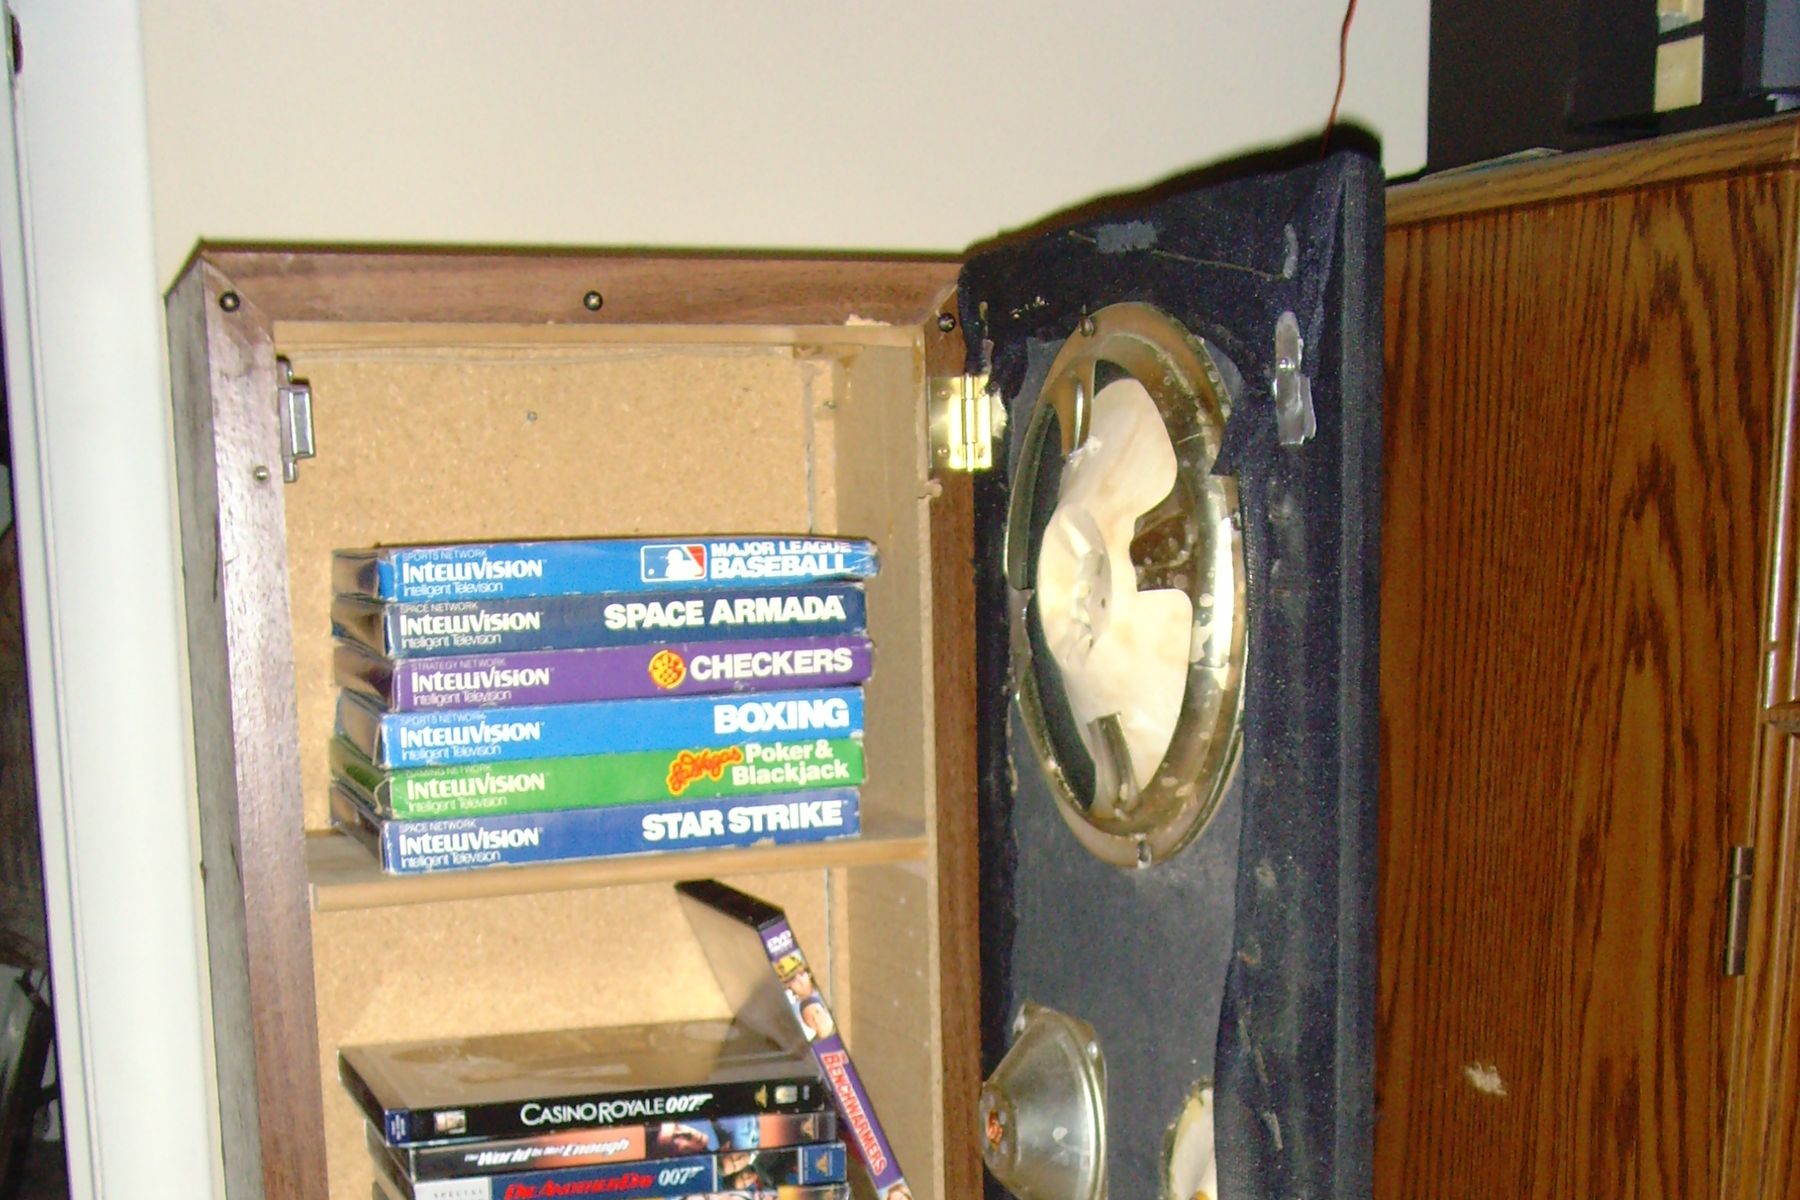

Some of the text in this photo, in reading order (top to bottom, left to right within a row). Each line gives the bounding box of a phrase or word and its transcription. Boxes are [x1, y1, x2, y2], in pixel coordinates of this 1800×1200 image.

[402, 549, 487, 562] SPORTS NETWORK
[710, 540, 852, 557] MAJOR LEAGUE
[710, 553, 853, 580] BASEBALL
[403, 581, 504, 598] Intelligent Television
[400, 602, 478, 614] SPACE NETWORK
[603, 595, 847, 629] SPACE ARMADA
[401, 633, 502, 650] Intelligent Television
[412, 658, 506, 670] STRATEGY NETWORK
[690, 648, 853, 681] CHECKERS
[412, 689, 512, 706] Intelligent Television
[439, 712, 487, 723] NETWORK
[714, 698, 850, 734] BOXING
[401, 744, 502, 763] Intelligent Television
[744, 739, 834, 764] Poker &
[447, 764, 492, 776] NETWORK
[732, 759, 849, 786] Blackjack
[406, 795, 508, 814] Intelligent Television
[400, 819, 477, 833] SPACE NETWORK
[642, 800, 844, 841] STAR STRIKE
[401, 851, 501, 868] Intelligent Television
[520, 1094, 707, 1126] CASINO ROYALE 007
[820, 1051, 888, 1176] BENCHWARMERS
[477, 1148, 533, 1166] World
[562, 1138, 630, 1158] Enough
[657, 1166, 701, 1187] 007
[433, 1188, 485, 1199] SPECIAL
